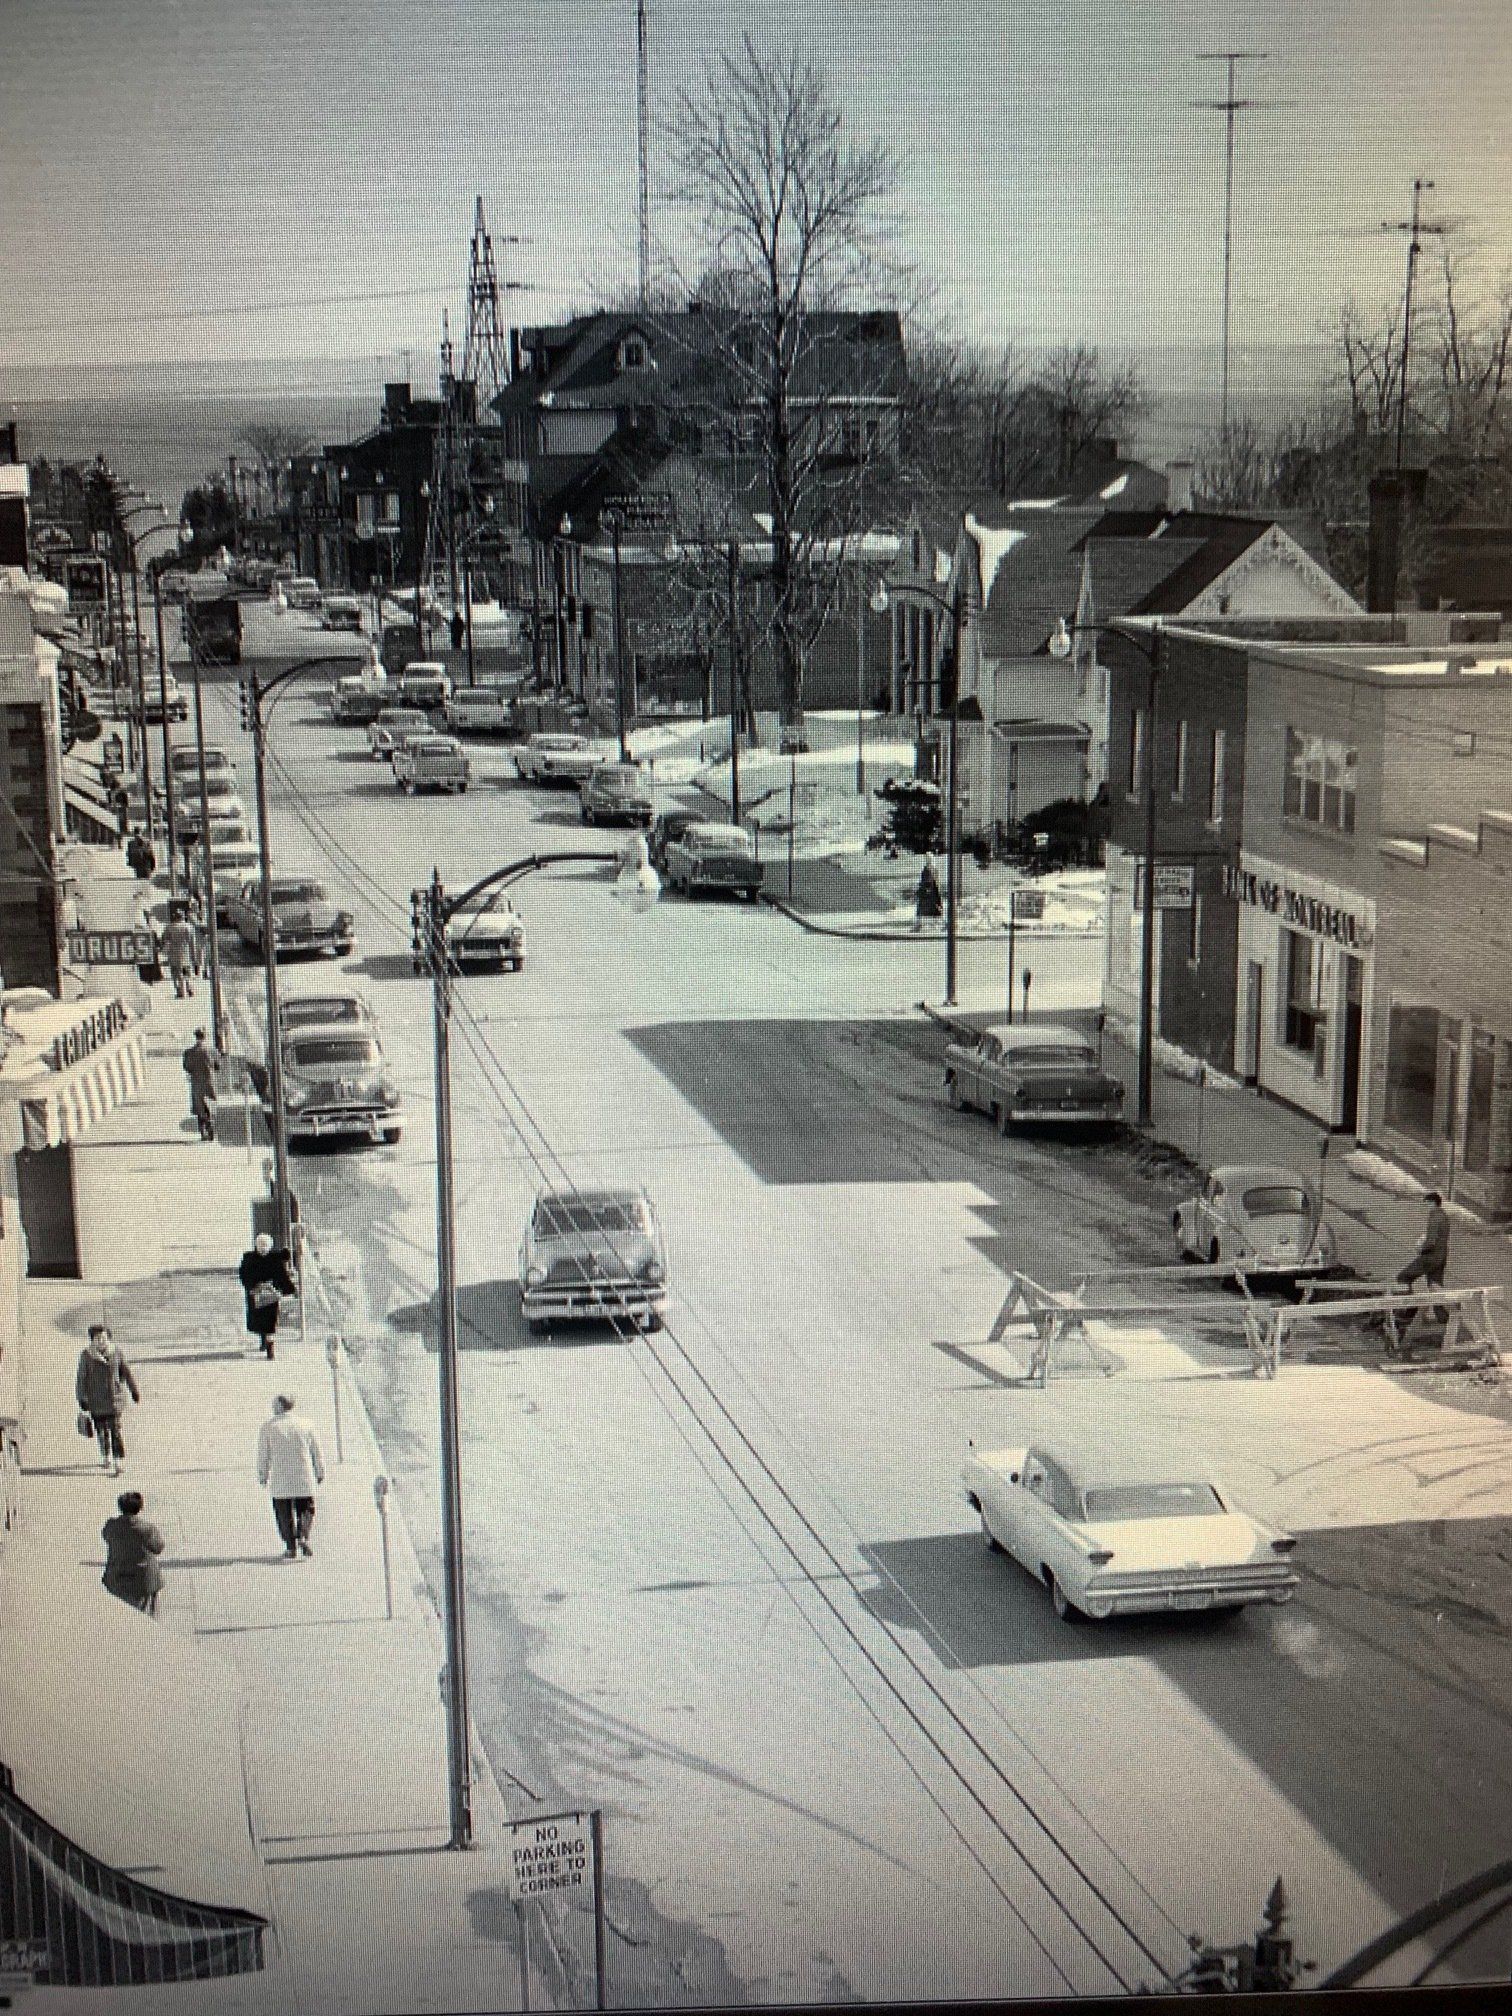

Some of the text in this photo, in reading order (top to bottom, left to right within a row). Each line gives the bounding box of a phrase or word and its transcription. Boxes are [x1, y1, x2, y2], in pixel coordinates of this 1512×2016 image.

[71, 935, 153, 962] DRUGS
[535, 1826, 559, 1844] NO
[512, 1838, 586, 1864] PARKING
[515, 1856, 587, 1880] HERE TO
[519, 1871, 583, 1895] CORNER
